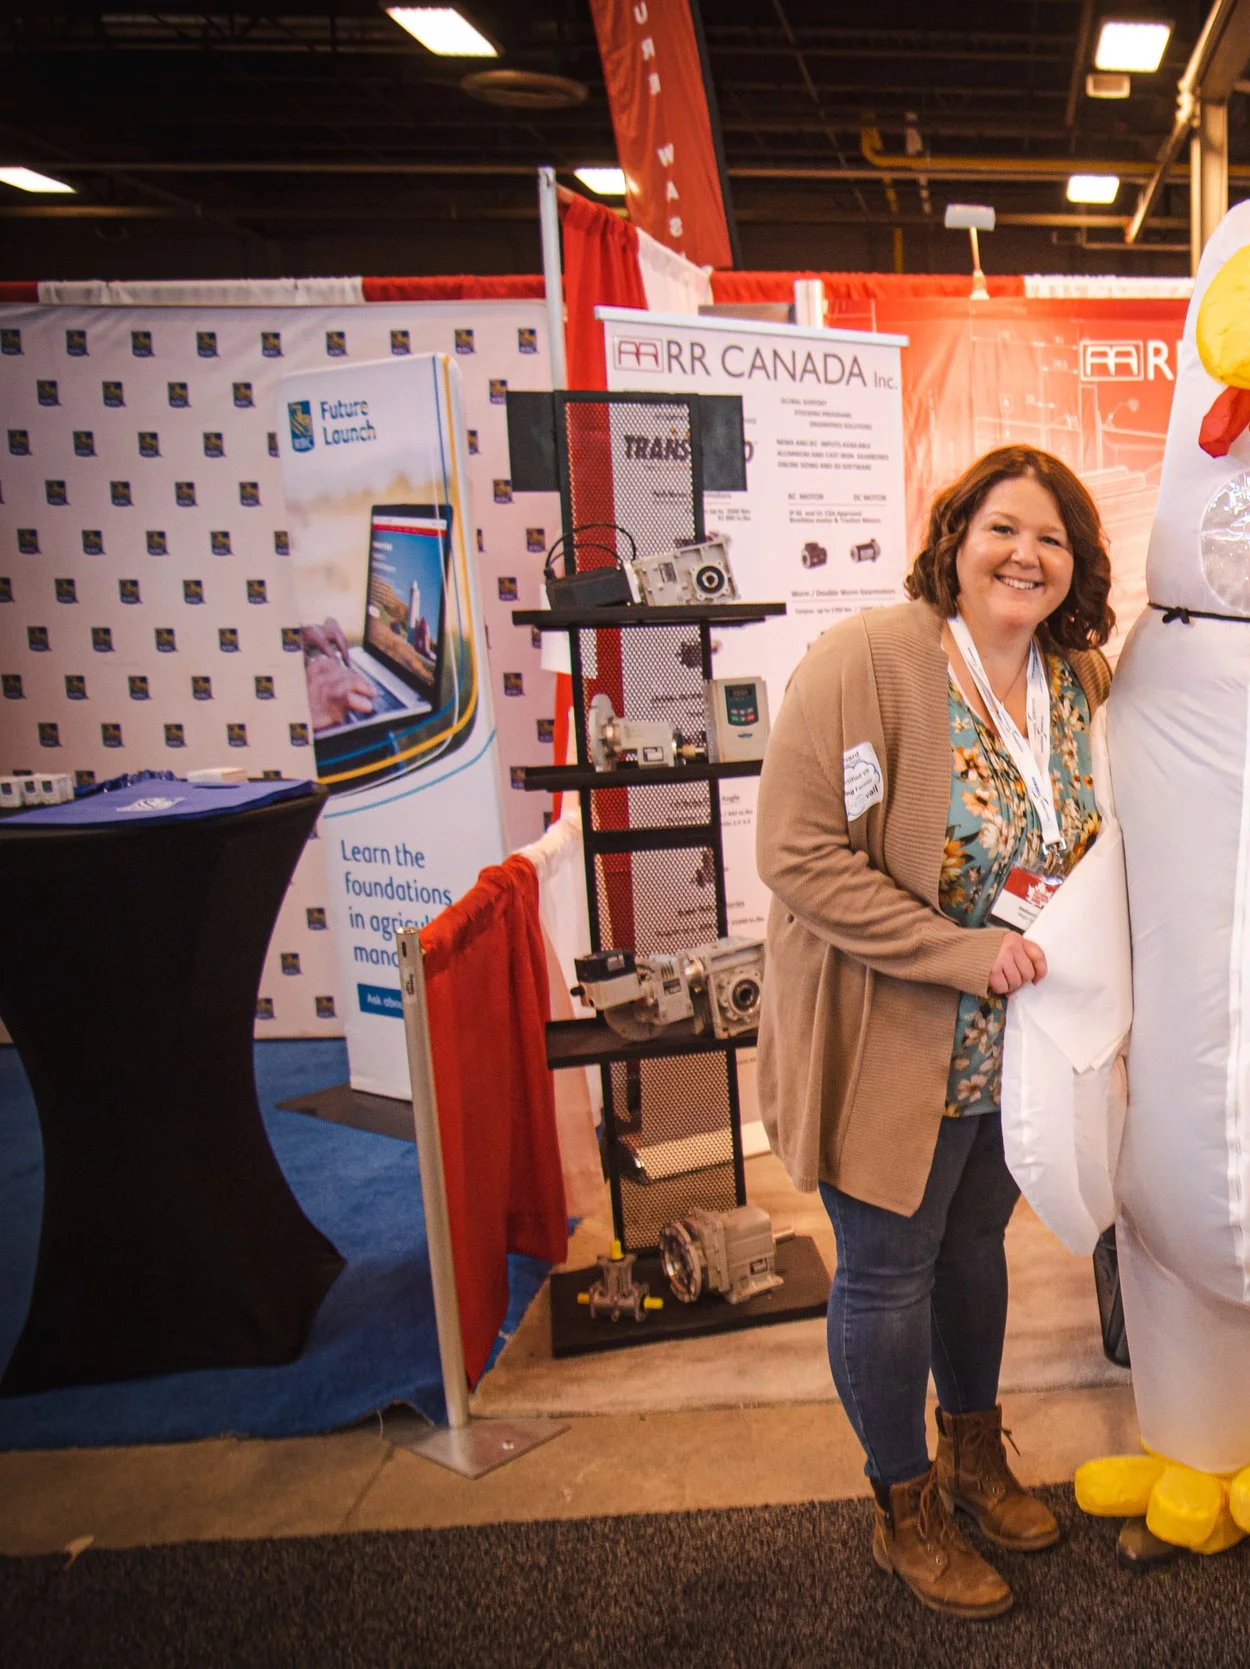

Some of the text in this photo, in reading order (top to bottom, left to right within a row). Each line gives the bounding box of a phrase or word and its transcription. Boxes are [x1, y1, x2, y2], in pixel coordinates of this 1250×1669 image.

[667, 340, 711, 377] RR
[721, 345, 867, 388] CANADA
[875, 374, 898, 391] Inc.
[1147, 340, 1183, 380] R
[320, 400, 369, 420] Future
[323, 419, 377, 446] Launch
[341, 840, 425, 868] Learn the
[345, 872, 453, 906] foundations
[348, 906, 365, 929] in
